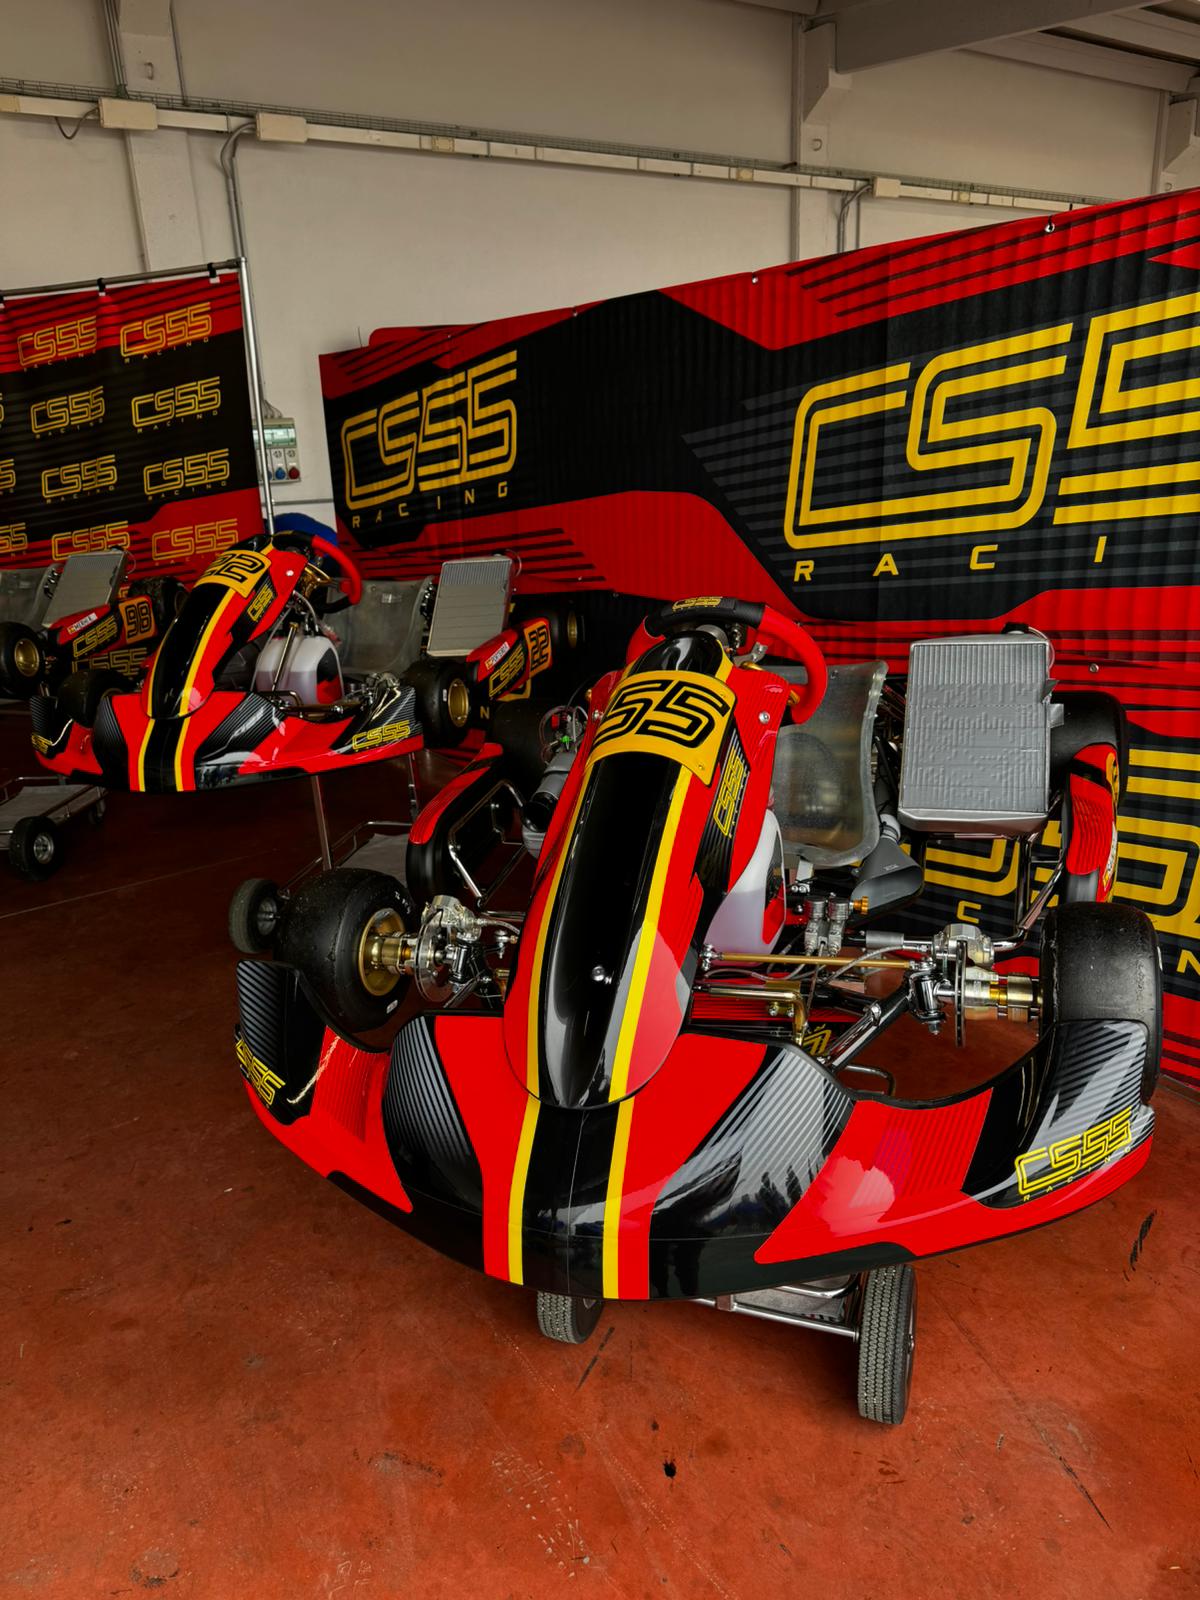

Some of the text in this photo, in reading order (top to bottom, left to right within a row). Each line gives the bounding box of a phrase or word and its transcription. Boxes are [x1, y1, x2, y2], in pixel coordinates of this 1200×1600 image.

[352, 481, 508, 528] RACING
[125, 601, 152, 638] 98
[593, 679, 731, 749] 55
